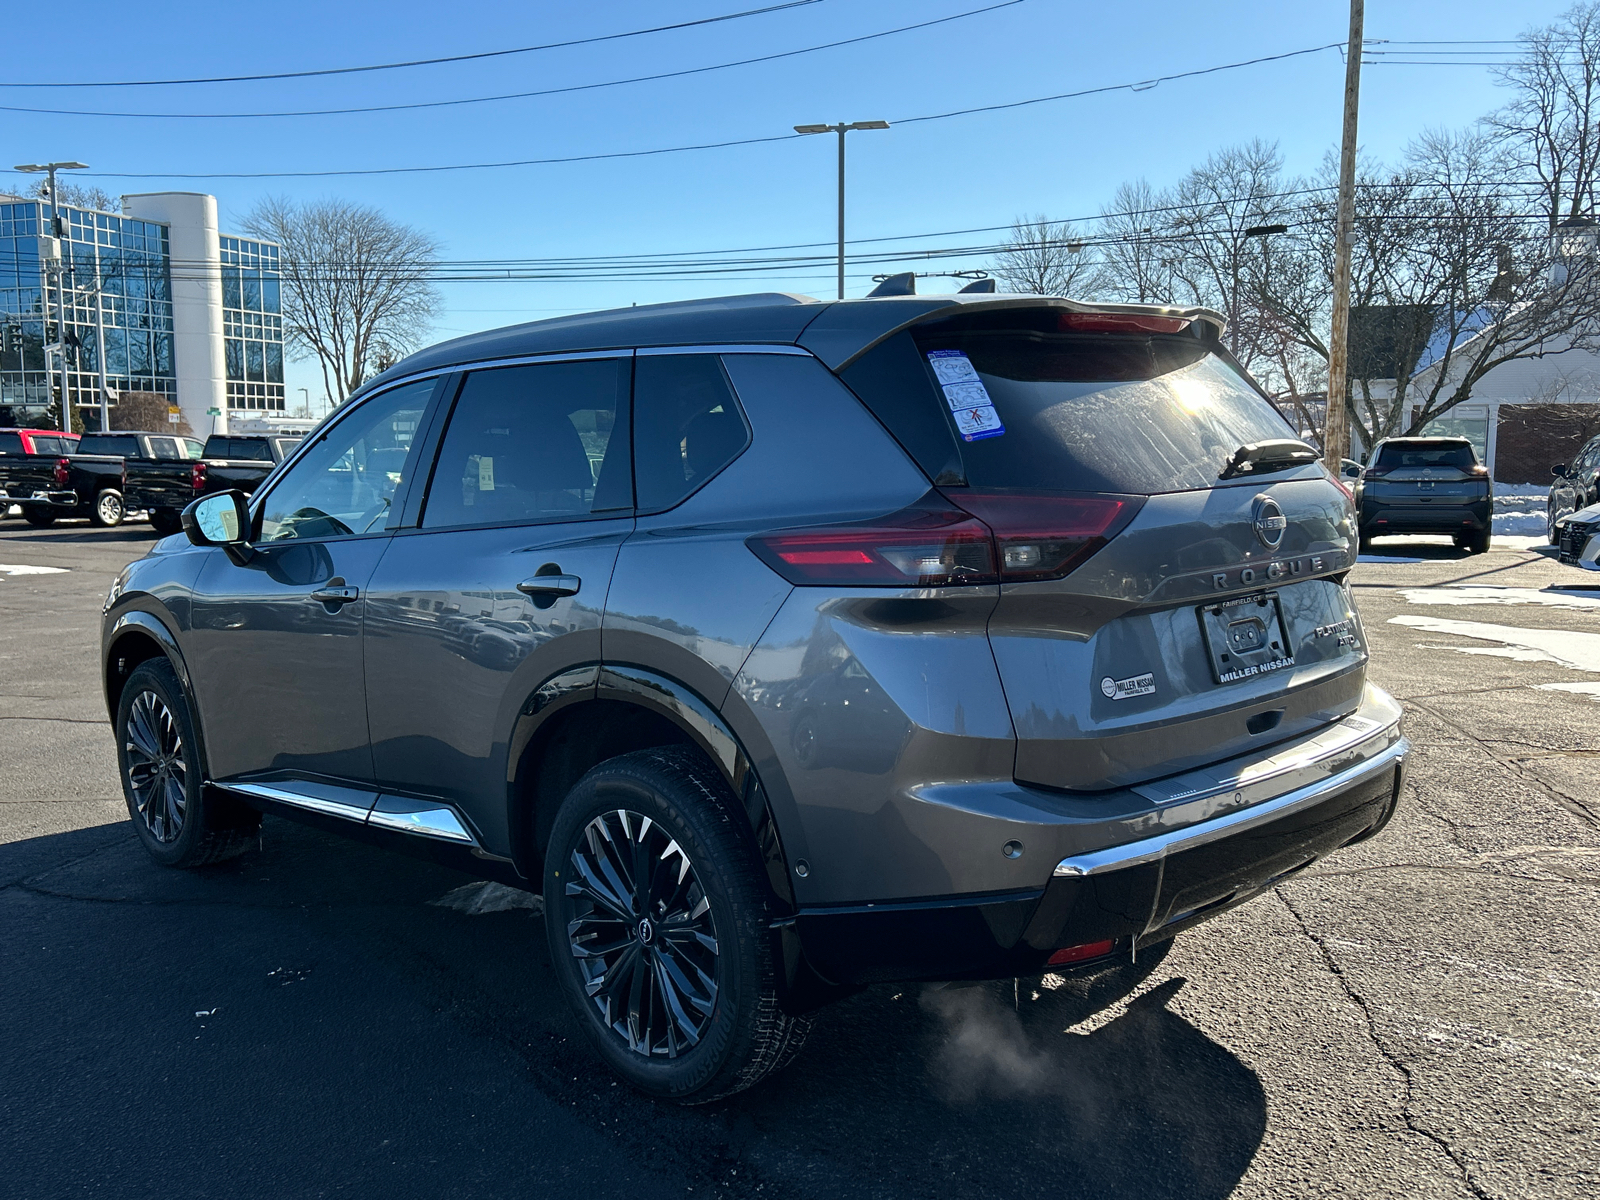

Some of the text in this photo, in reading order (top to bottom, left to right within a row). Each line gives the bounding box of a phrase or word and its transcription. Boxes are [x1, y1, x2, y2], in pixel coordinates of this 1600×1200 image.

[1256, 519, 1285, 530] NISS
[1213, 556, 1323, 590] ROGUE
[1314, 619, 1352, 638] PLATINUM
[1337, 634, 1355, 647] AWD
[1220, 656, 1295, 683] MILLER NISSAN
[1117, 677, 1154, 692] MILLER NISSAN
